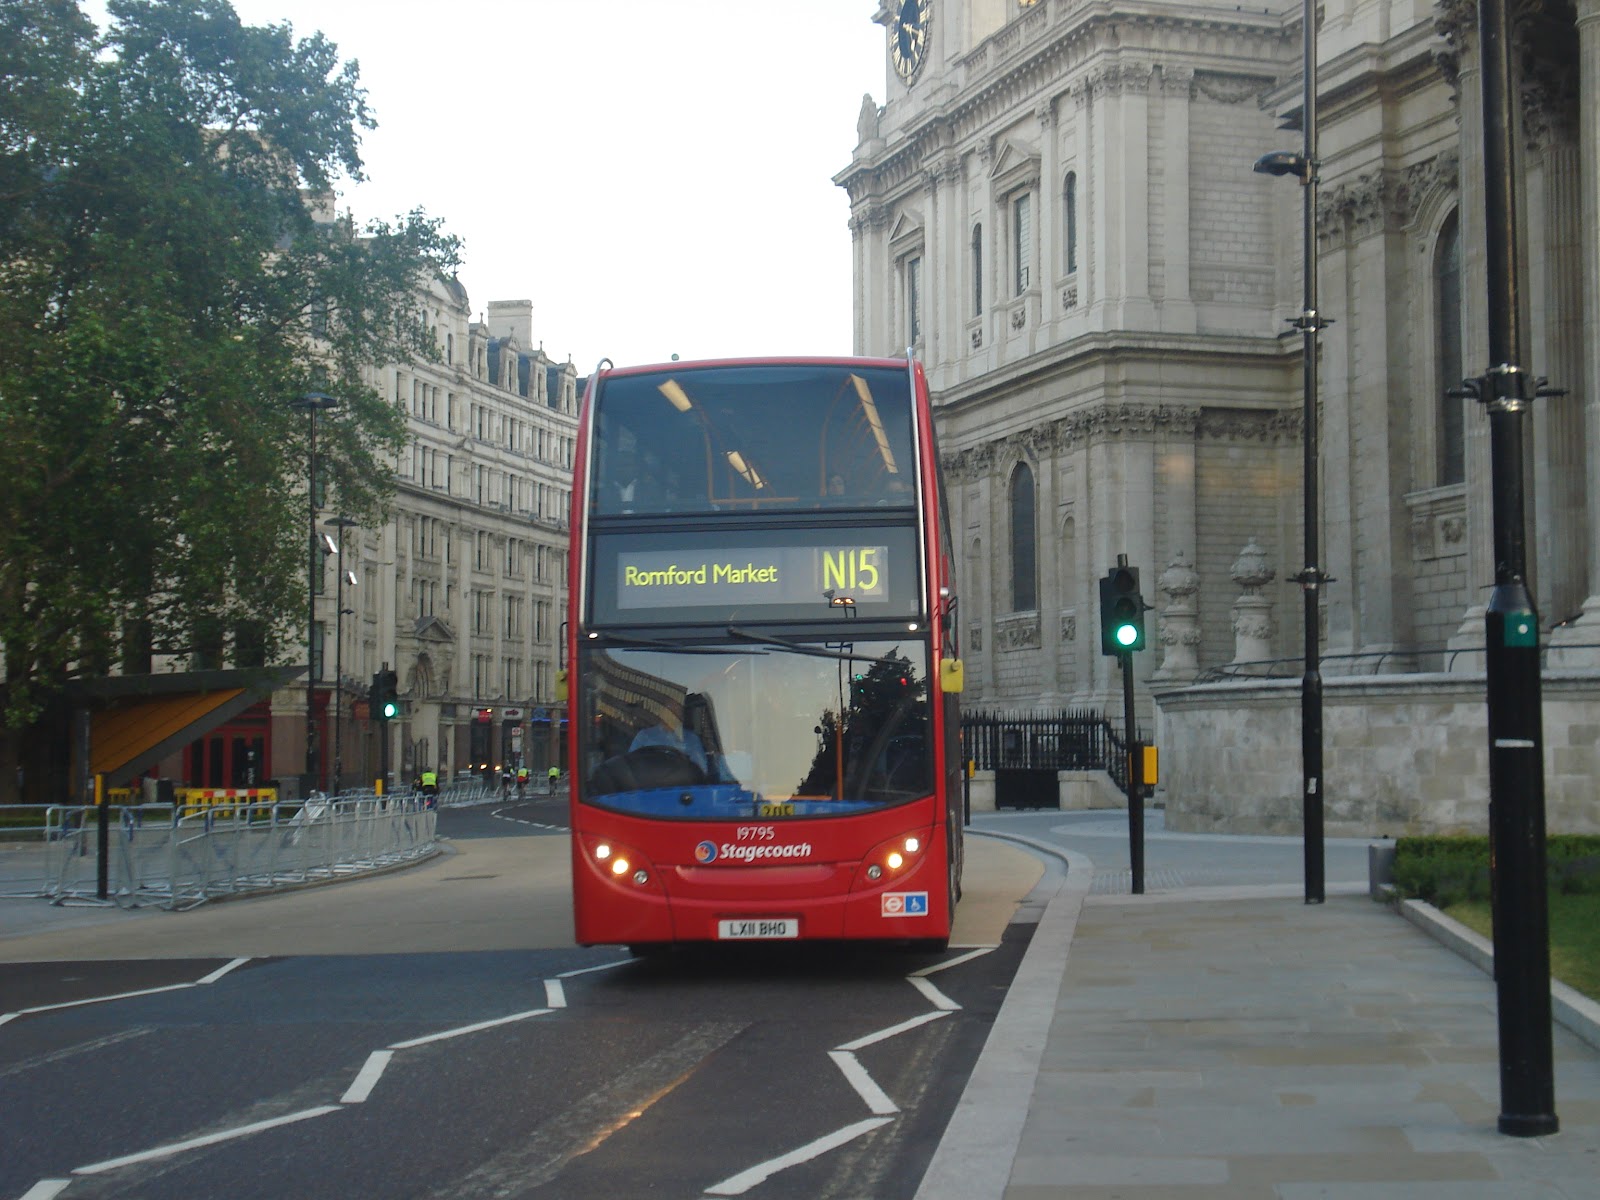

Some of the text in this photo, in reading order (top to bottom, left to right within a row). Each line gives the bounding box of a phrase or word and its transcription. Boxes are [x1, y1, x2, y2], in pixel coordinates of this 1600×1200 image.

[625, 563, 778, 586] Romford Market
[823, 549, 879, 590] N15
[737, 825, 775, 841] 19795
[720, 842, 812, 863] Stagecoach
[730, 921, 786, 936] LX11 BHO
